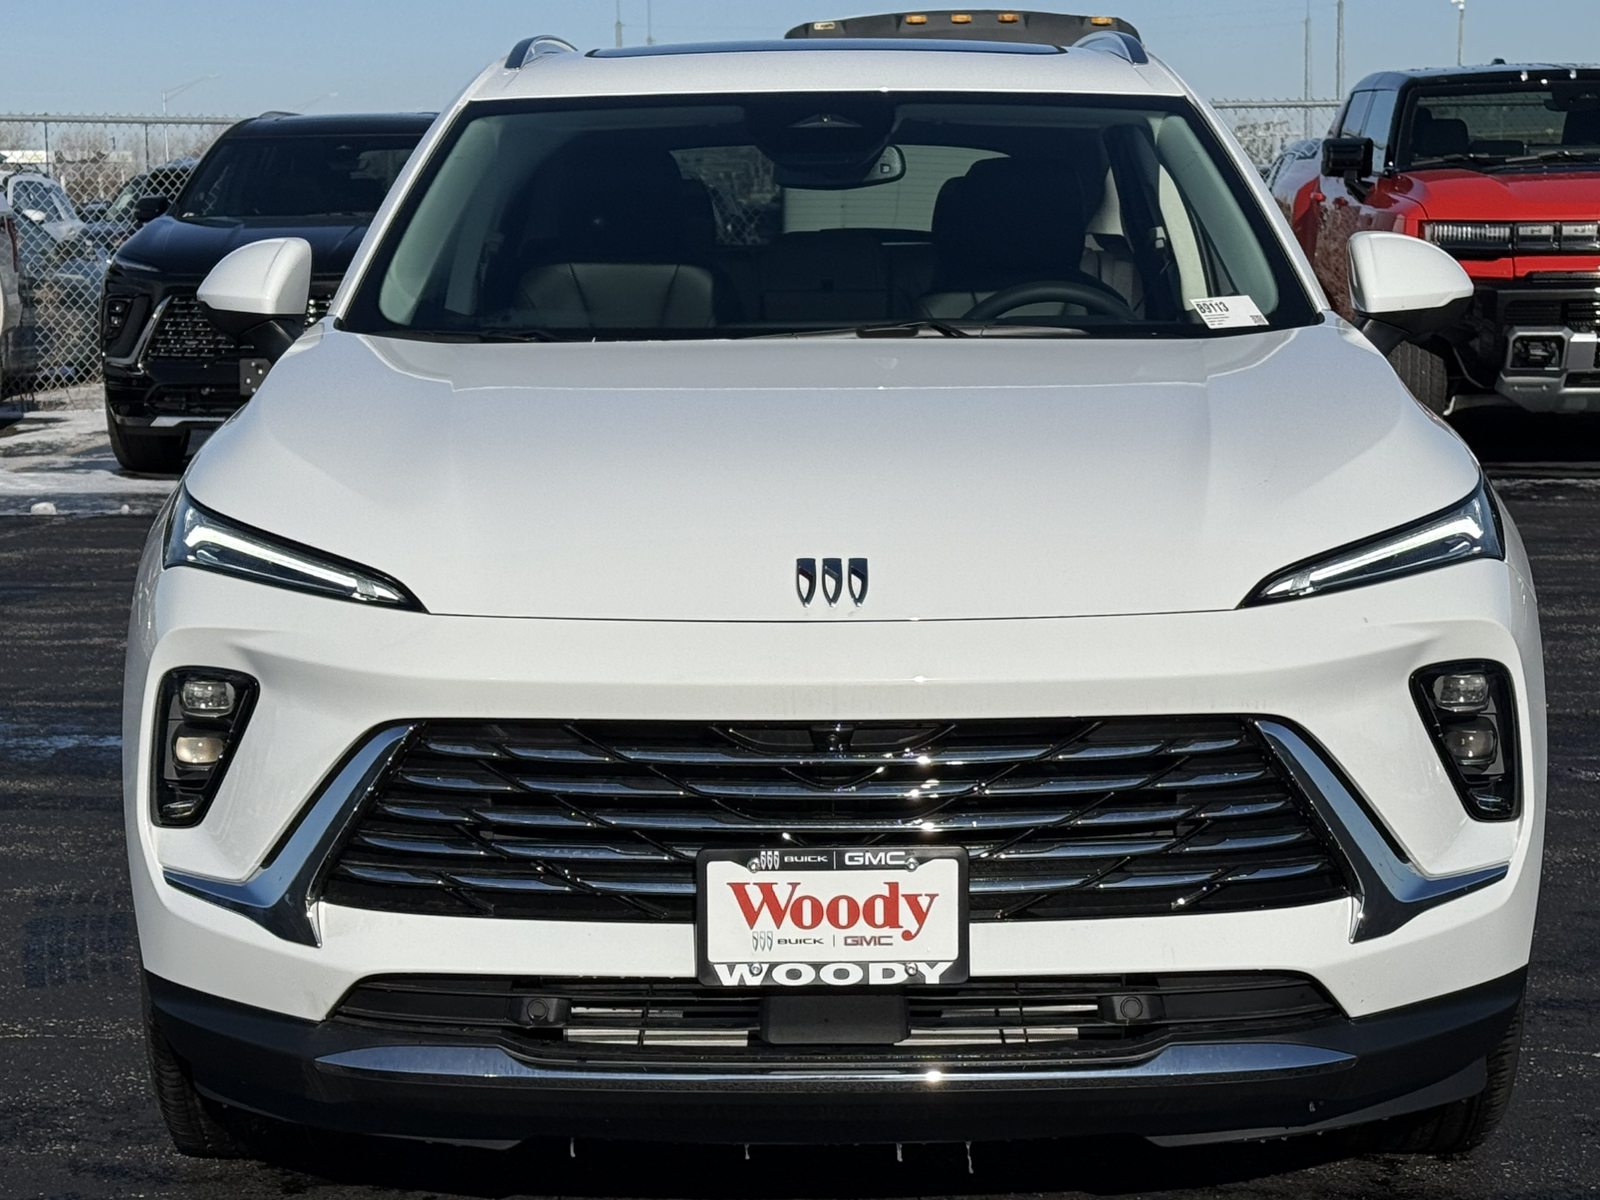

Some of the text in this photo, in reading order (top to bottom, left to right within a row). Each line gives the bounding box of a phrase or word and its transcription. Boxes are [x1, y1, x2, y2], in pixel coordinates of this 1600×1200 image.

[784, 851, 906, 866] BUICK GMC
[726, 881, 939, 942] Woody
[843, 935, 894, 947] GMC
[713, 962, 954, 986] WOODY
